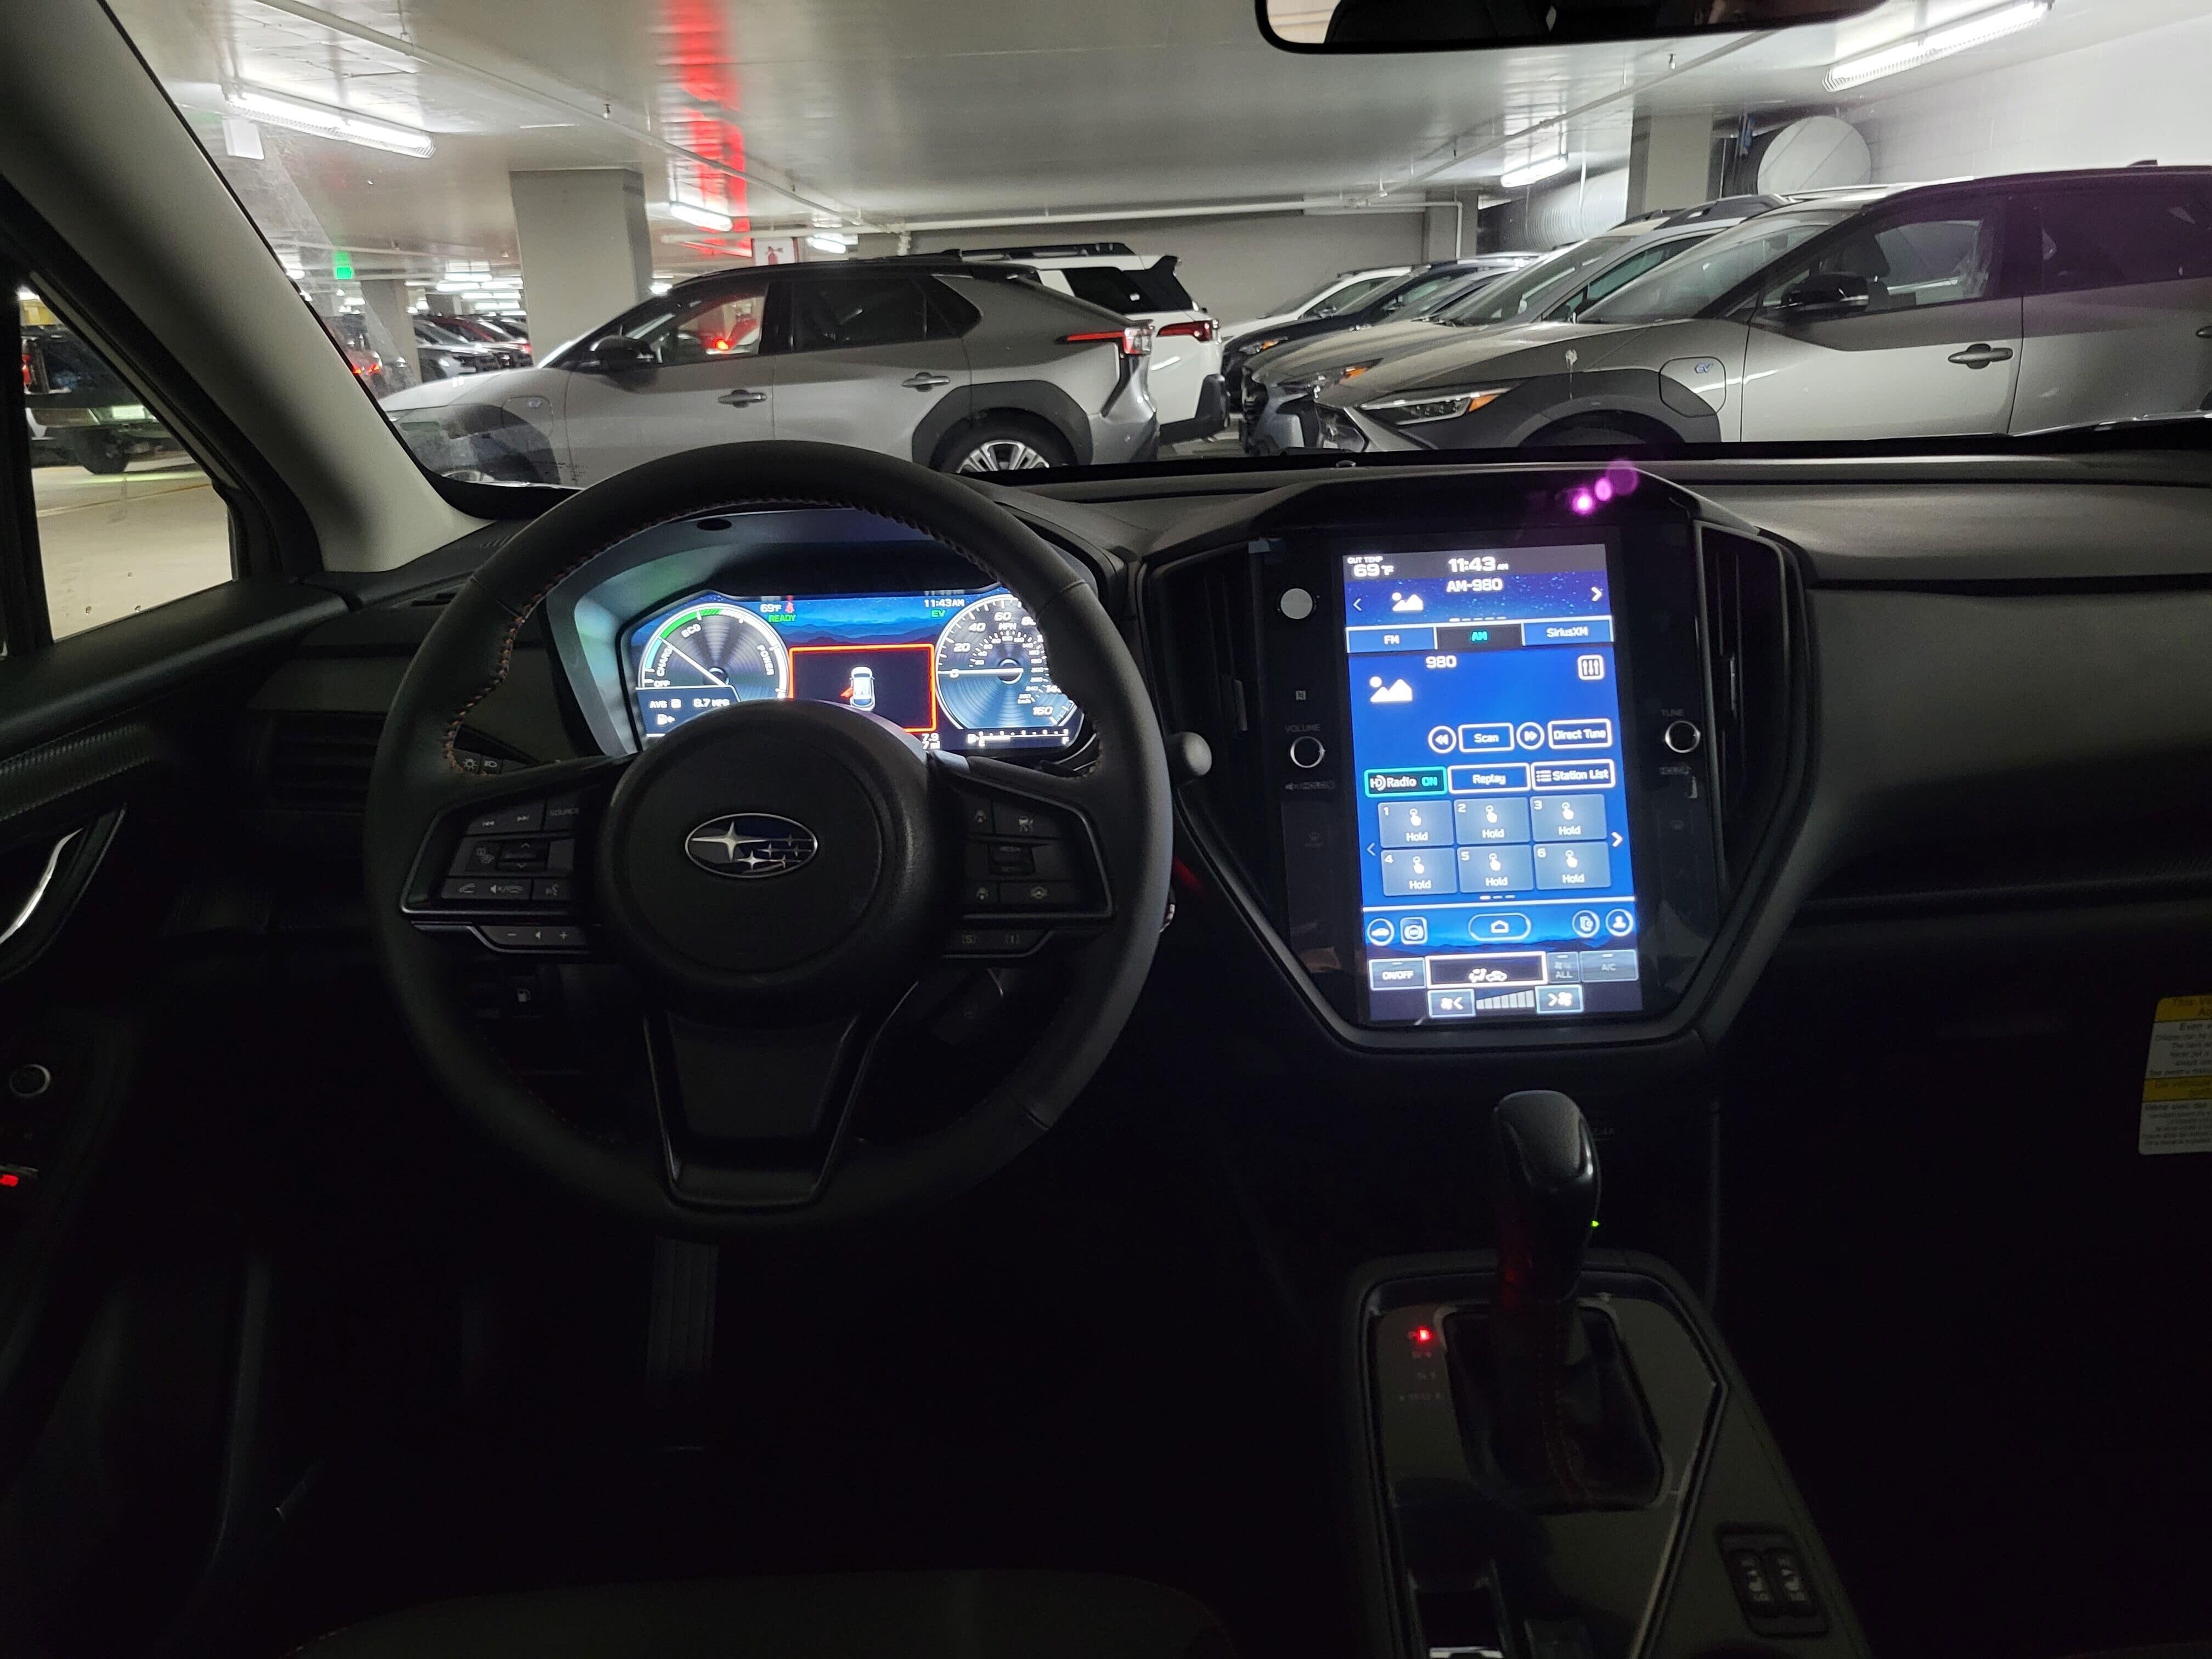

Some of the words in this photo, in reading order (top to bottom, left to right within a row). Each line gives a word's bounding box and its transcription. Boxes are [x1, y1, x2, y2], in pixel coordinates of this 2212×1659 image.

[1448, 556, 1496, 573] 11:43
[1446, 578, 1503, 592] AM-980
[994, 612, 1012, 621] 60
[681, 623, 702, 638] ECO
[968, 622, 986, 632] 40
[1471, 631, 1488, 641] AM
[1546, 627, 1589, 638] SiriusXM
[1384, 634, 1400, 645] FM
[953, 642, 971, 652] 20
[757, 645, 775, 676] POWER
[1426, 655, 1457, 668] 980
[650, 700, 668, 708] AVG
[693, 698, 710, 708] 8.7
[1032, 706, 1053, 716] 160
[1284, 724, 1321, 732] VOLUME
[1474, 733, 1499, 743] Scan
[1553, 729, 1582, 740] Direct
[1583, 728, 1606, 739] Tune
[1472, 773, 1505, 786] Replay
[1552, 769, 1587, 781] Station
[1589, 768, 1609, 780] List
[1387, 776, 1417, 788] Radio
[1421, 776, 1438, 787] ON
[1458, 803, 1466, 813] 2
[1534, 800, 1543, 810] 3
[1383, 806, 1389, 816] 1
[1482, 828, 1505, 838] Hold
[1559, 825, 1581, 836] Hold
[1406, 831, 1428, 842] Hold
[1461, 851, 1470, 861] 5
[1537, 848, 1547, 857] 6
[1385, 854, 1393, 864] 4
[1485, 876, 1508, 887] Hold
[1562, 873, 1584, 883] Hold
[1409, 879, 1431, 890] Hold
[1601, 963, 1617, 971] A/C
[1382, 970, 1414, 981] ON/OFF
[1555, 970, 1573, 979] ALL
